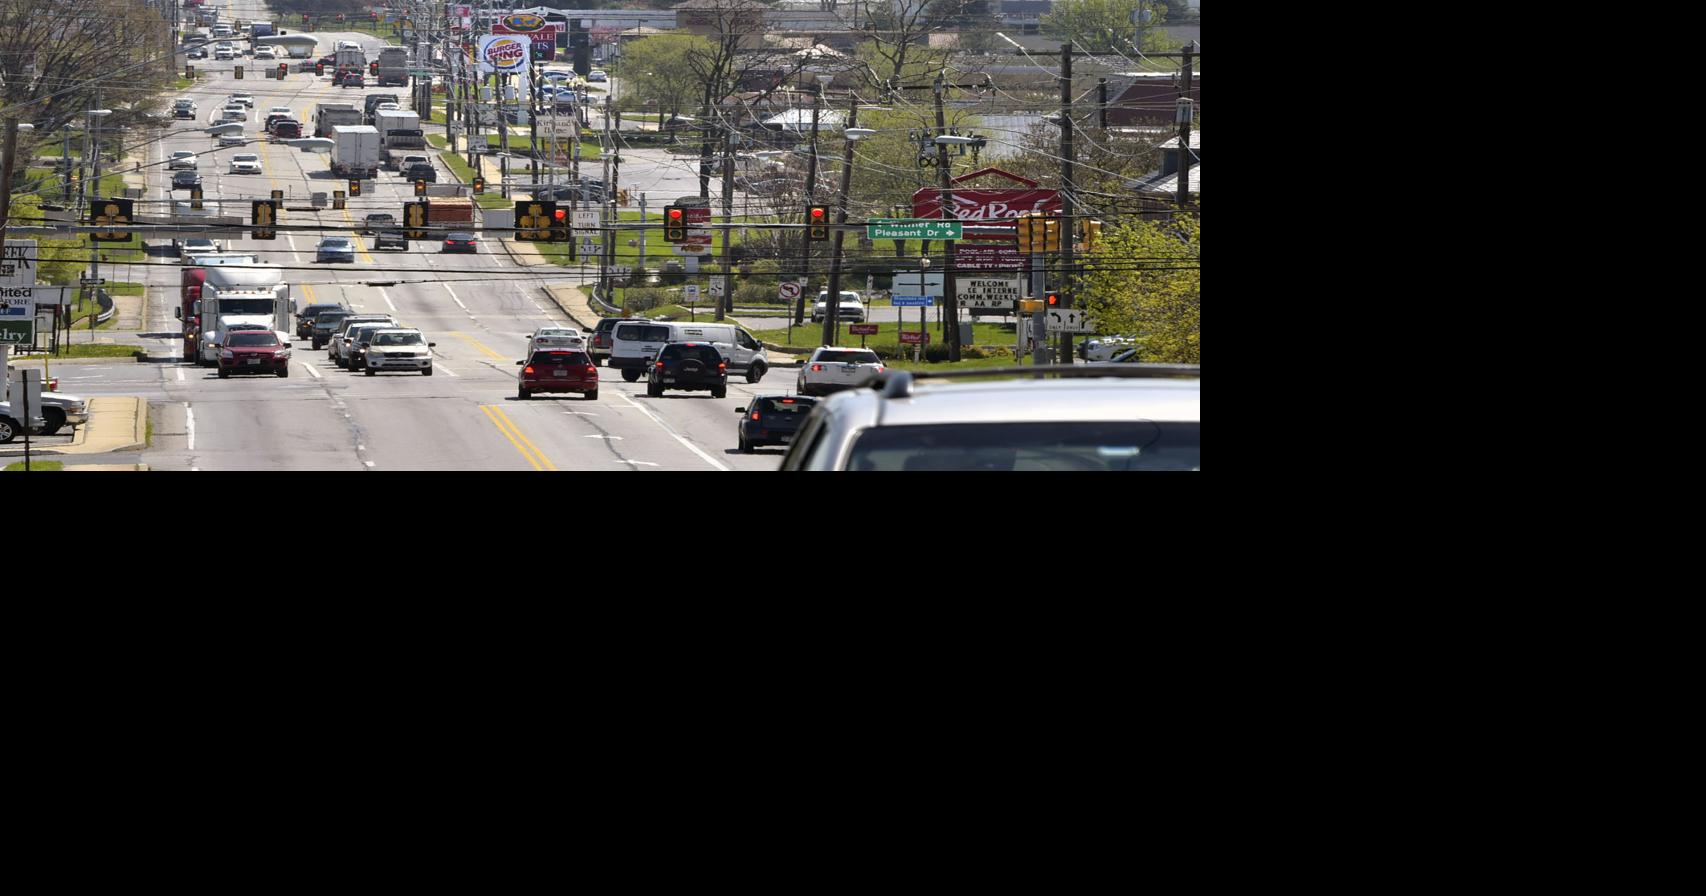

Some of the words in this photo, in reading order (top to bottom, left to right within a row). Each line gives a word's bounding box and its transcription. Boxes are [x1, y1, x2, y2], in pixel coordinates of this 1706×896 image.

[487, 43, 522, 55] BURGER
[489, 49, 523, 60] KING
[874, 229, 921, 237] Pleasant
[927, 229, 940, 237] Dr
